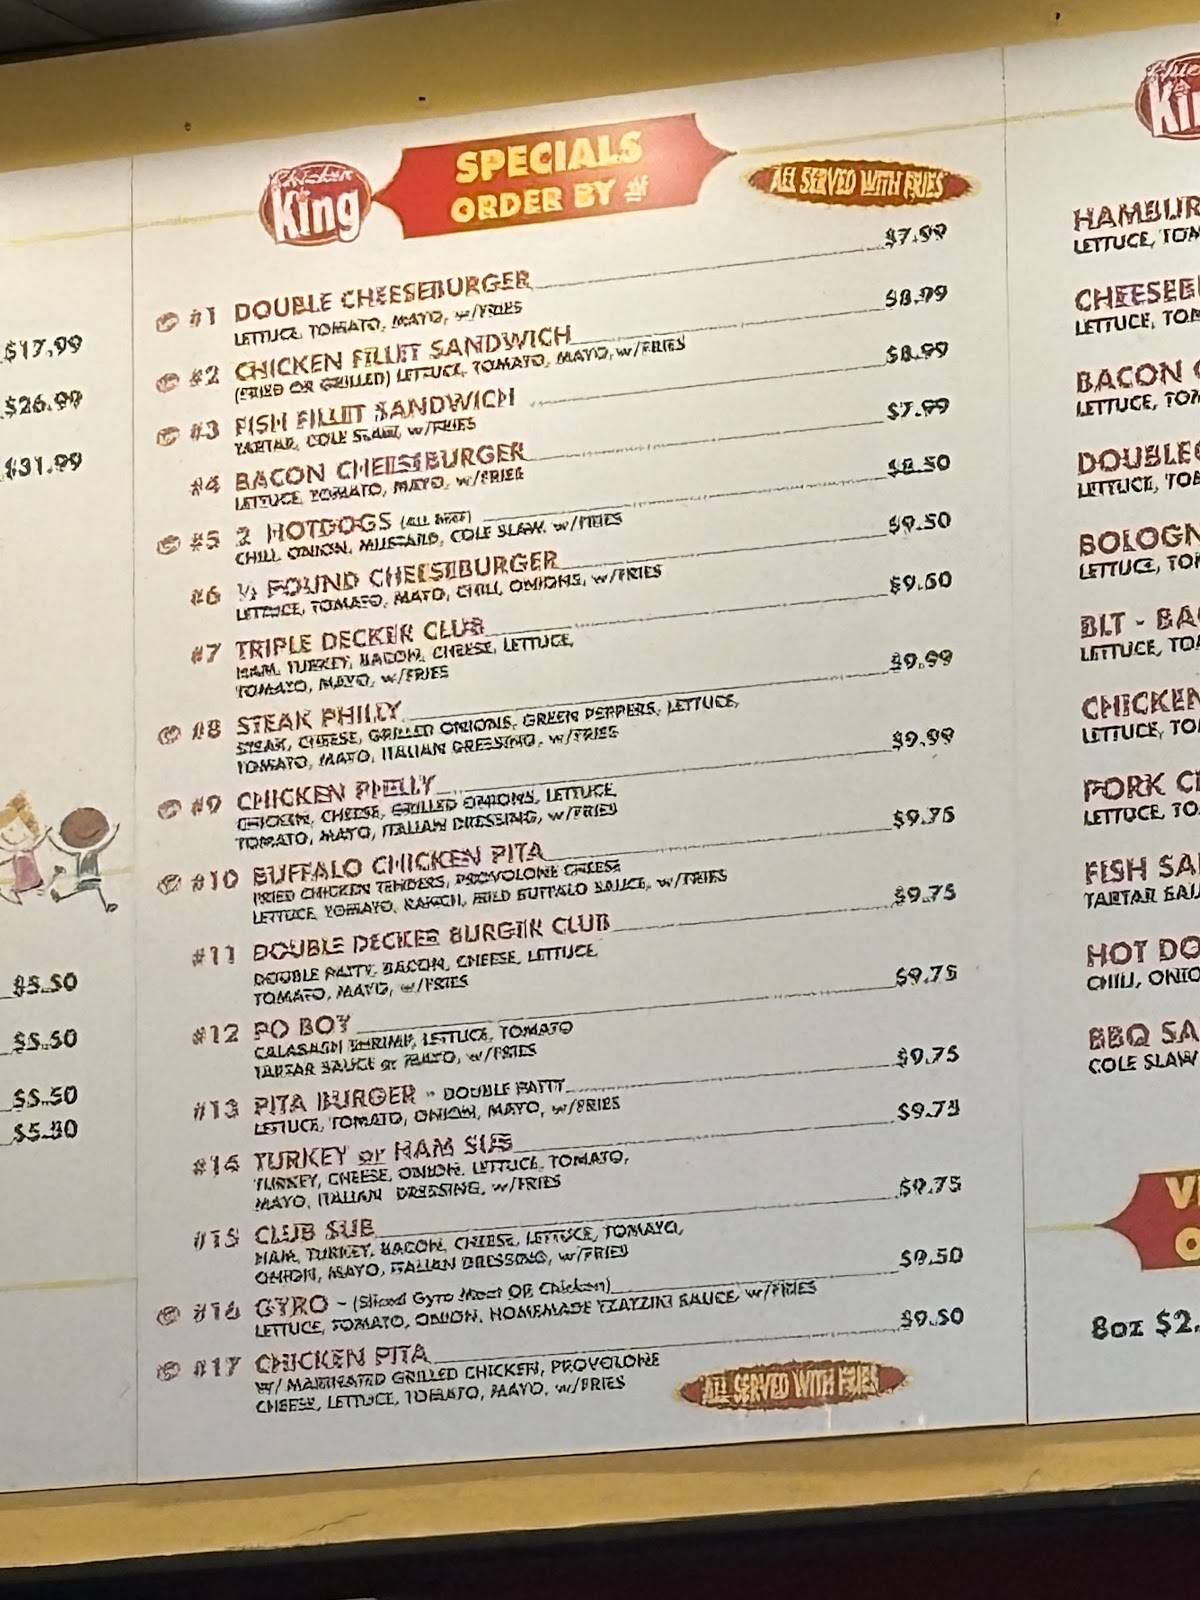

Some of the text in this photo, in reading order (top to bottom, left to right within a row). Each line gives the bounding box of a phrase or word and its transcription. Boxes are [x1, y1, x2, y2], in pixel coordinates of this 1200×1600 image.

[456, 131, 642, 184] SPECIALS
[451, 187, 563, 222] ORDER
[574, 178, 616, 208] BY
[771, 167, 944, 201] ALL SERVED WITH FRIES
[271, 187, 361, 243] King
[1073, 196, 1200, 232] HAMBUR
[190, 306, 216, 327] #1
[235, 292, 333, 323] DOUBLE
[1075, 278, 1200, 312] CHEESEB
[189, 365, 220, 388] #2
[235, 352, 342, 382] CHICKEN
[430, 325, 571, 360] SANDWICH
[1077, 360, 1183, 394] BACON
[190, 420, 220, 441] #3
[235, 412, 288, 437] FISH
[375, 387, 515, 423] SANDWICH
[236, 463, 325, 492] BACON
[190, 530, 220, 552] #5
[1080, 523, 1200, 558] BOLOGN
[191, 586, 221, 606] #6
[267, 571, 360, 599] POUND
[191, 642, 222, 665] #7
[235, 634, 312, 661] TRIPLE
[424, 617, 485, 641] CLUB
[192, 719, 222, 741] #8
[237, 709, 313, 736] STEAK
[191, 794, 222, 816] #9
[237, 783, 346, 811] CHICKEN
[191, 841, 545, 893] #10 BUFFALO CHICKEN PITA
[1086, 857, 1147, 886] FISH
[192, 945, 235, 967] #11
[253, 936, 345, 962] DOUBLE
[449, 918, 544, 945] BURGER
[552, 913, 610, 935] CLUB
[1087, 940, 1149, 968] HOT
[1148, 966, 1200, 986] ONIO
[192, 1014, 351, 1046] #12 PO BOY
[1089, 1023, 1150, 1051] BBQ
[1088, 1050, 1199, 1075] COLE SLAW
[194, 1098, 239, 1121] #13
[254, 1094, 307, 1116] PITA
[317, 1084, 416, 1112] BURGER
[444, 1082, 511, 1101] DOUBLE
[253, 1145, 350, 1172] TURKEY
[395, 1137, 454, 1162] HAM
[464, 1133, 513, 1155] SUB
[194, 1218, 375, 1250] #15 CLUB SUB
[194, 1301, 241, 1324] #16
[254, 1295, 329, 1319] GYRO
[1091, 1308, 1200, 1341] 8oz $2.
[193, 1344, 431, 1378] #17 CHICKEN PITA
[734, 1372, 789, 1403] SERVED
[793, 1368, 834, 1398] WITH
